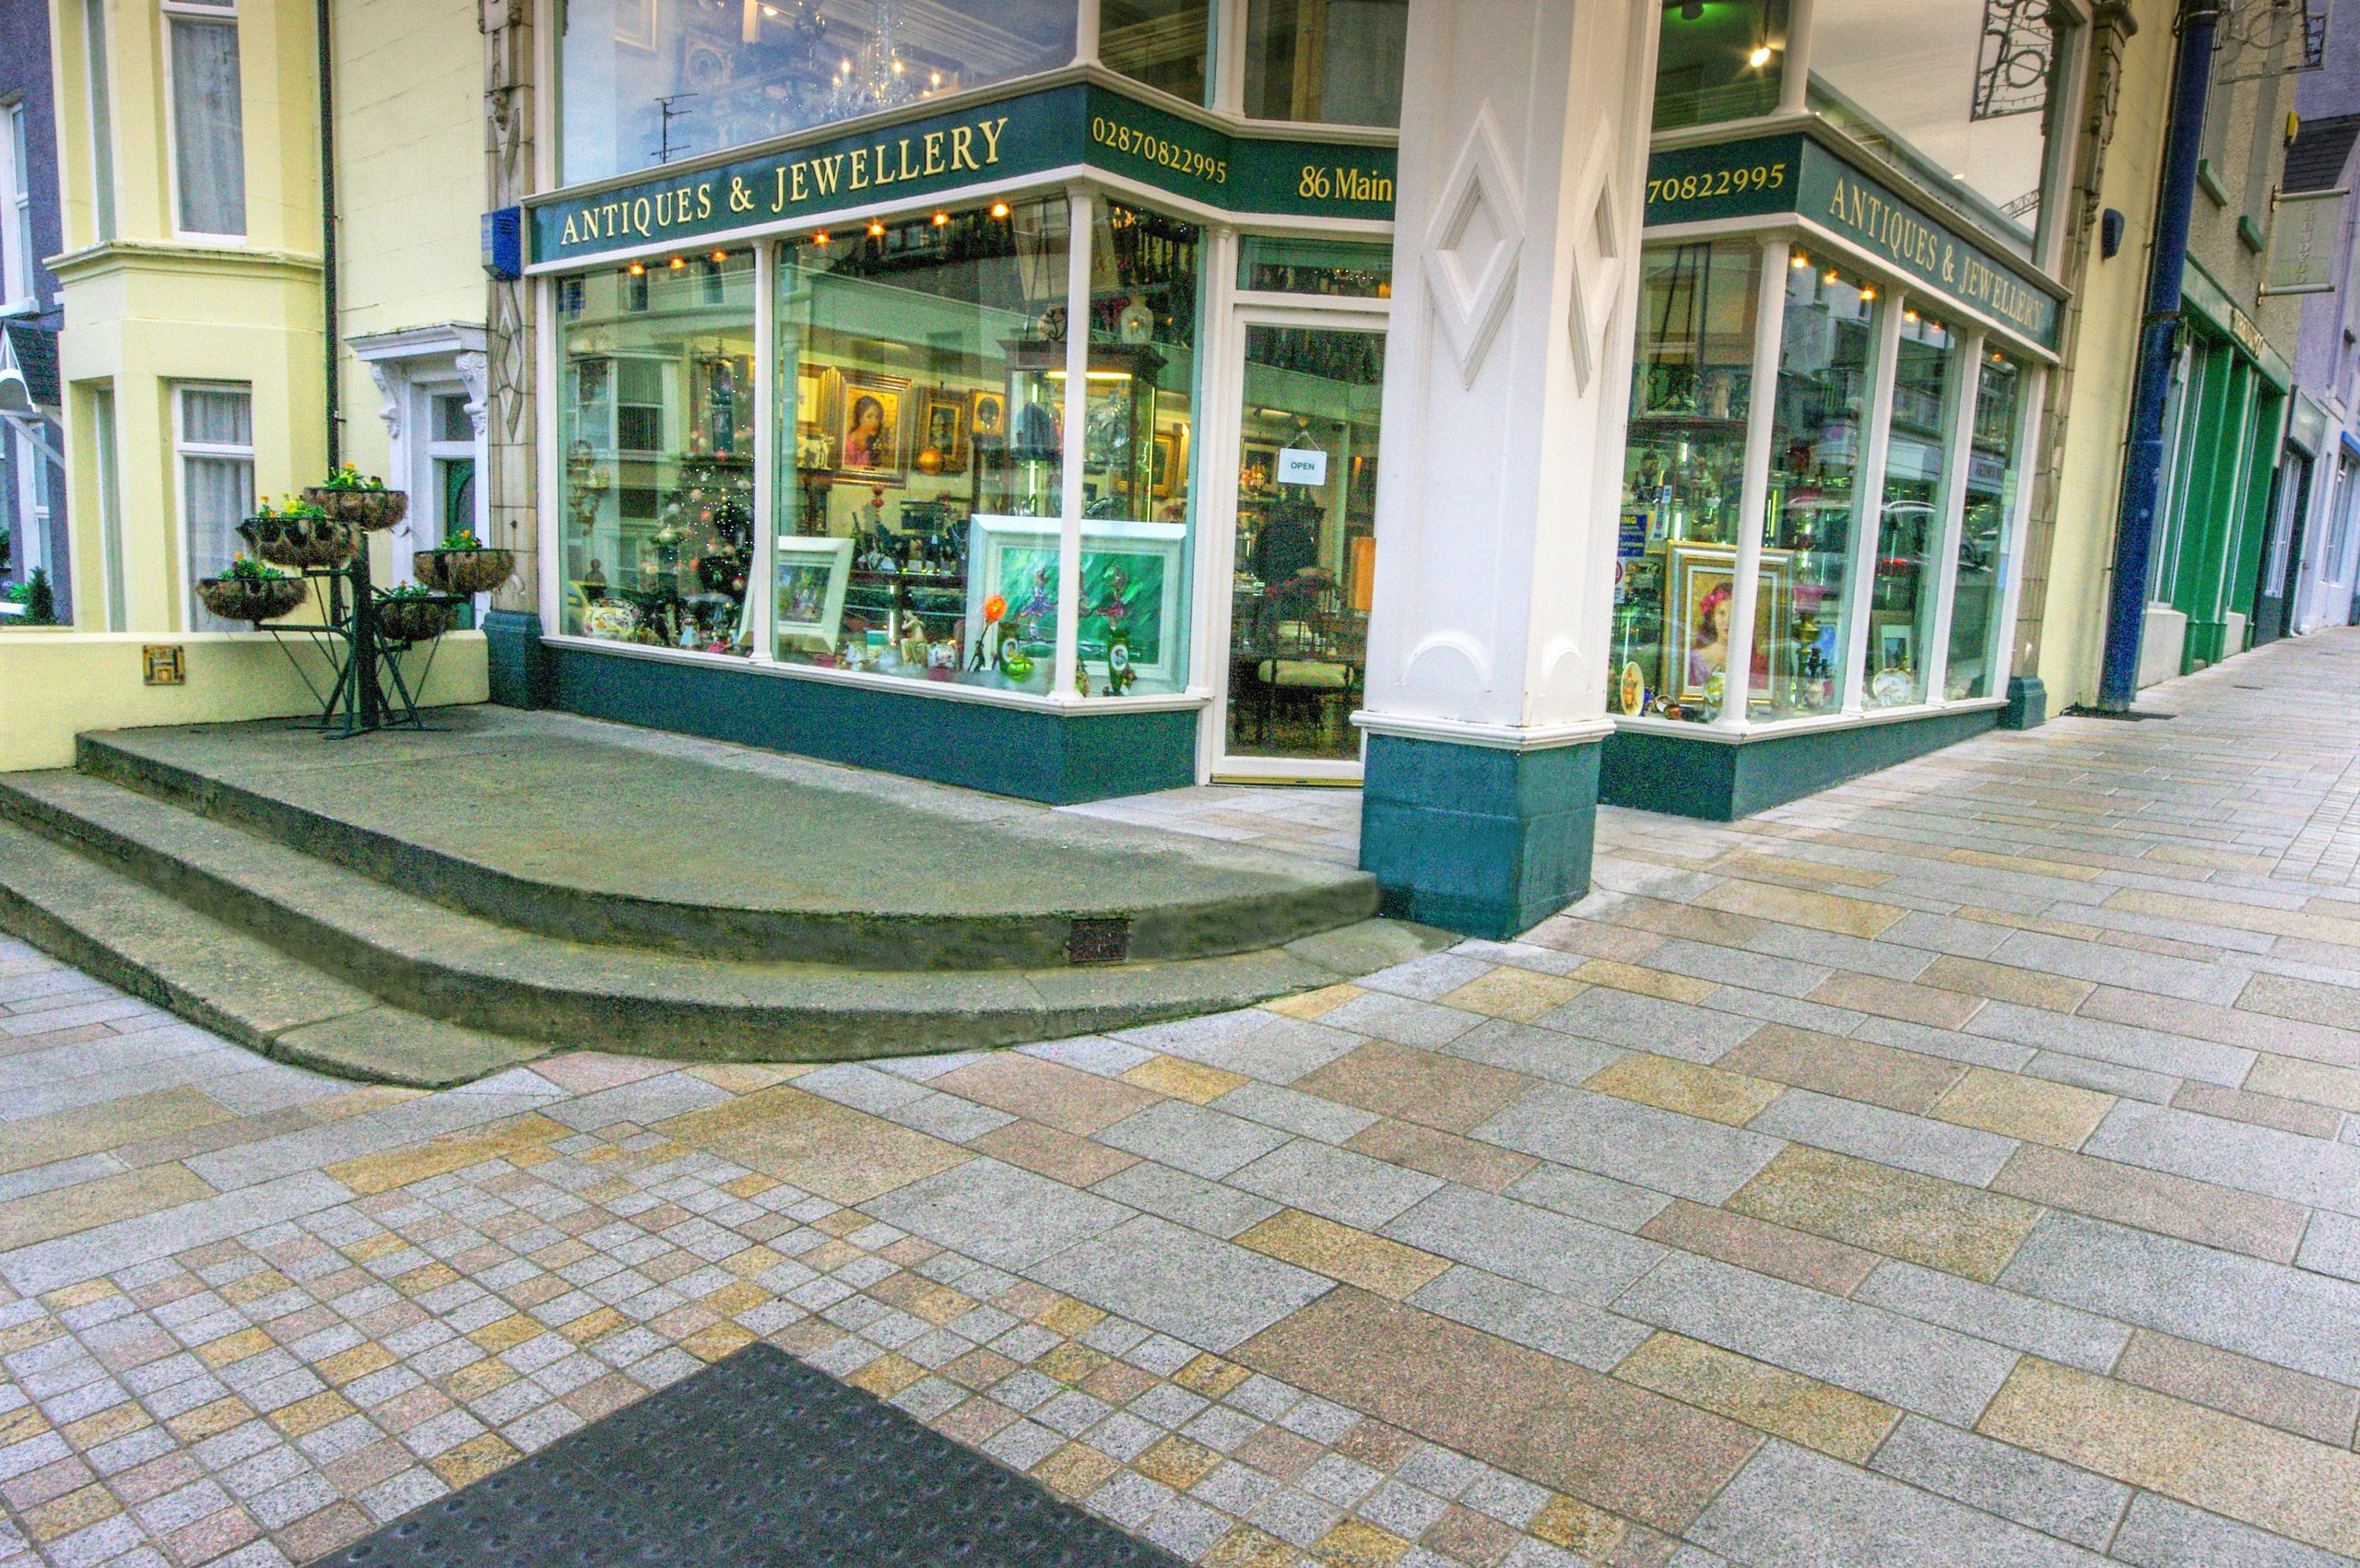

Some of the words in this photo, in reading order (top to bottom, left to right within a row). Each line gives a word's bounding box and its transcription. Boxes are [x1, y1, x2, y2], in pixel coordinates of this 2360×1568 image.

[1092, 117, 1227, 184] 02870822995
[560, 183, 711, 245] ANTIQUES
[730, 176, 755, 213] &
[771, 117, 1009, 213] JEWELLERY
[1299, 165, 1330, 198] 86
[1335, 168, 1393, 202] Main
[1647, 163, 1786, 205] 70822995
[1829, 177, 1937, 271] ANTIQUES
[1941, 243, 1954, 283] &
[1959, 256, 2044, 333] JEWELLERY
[1291, 462, 1315, 470] OPEN
